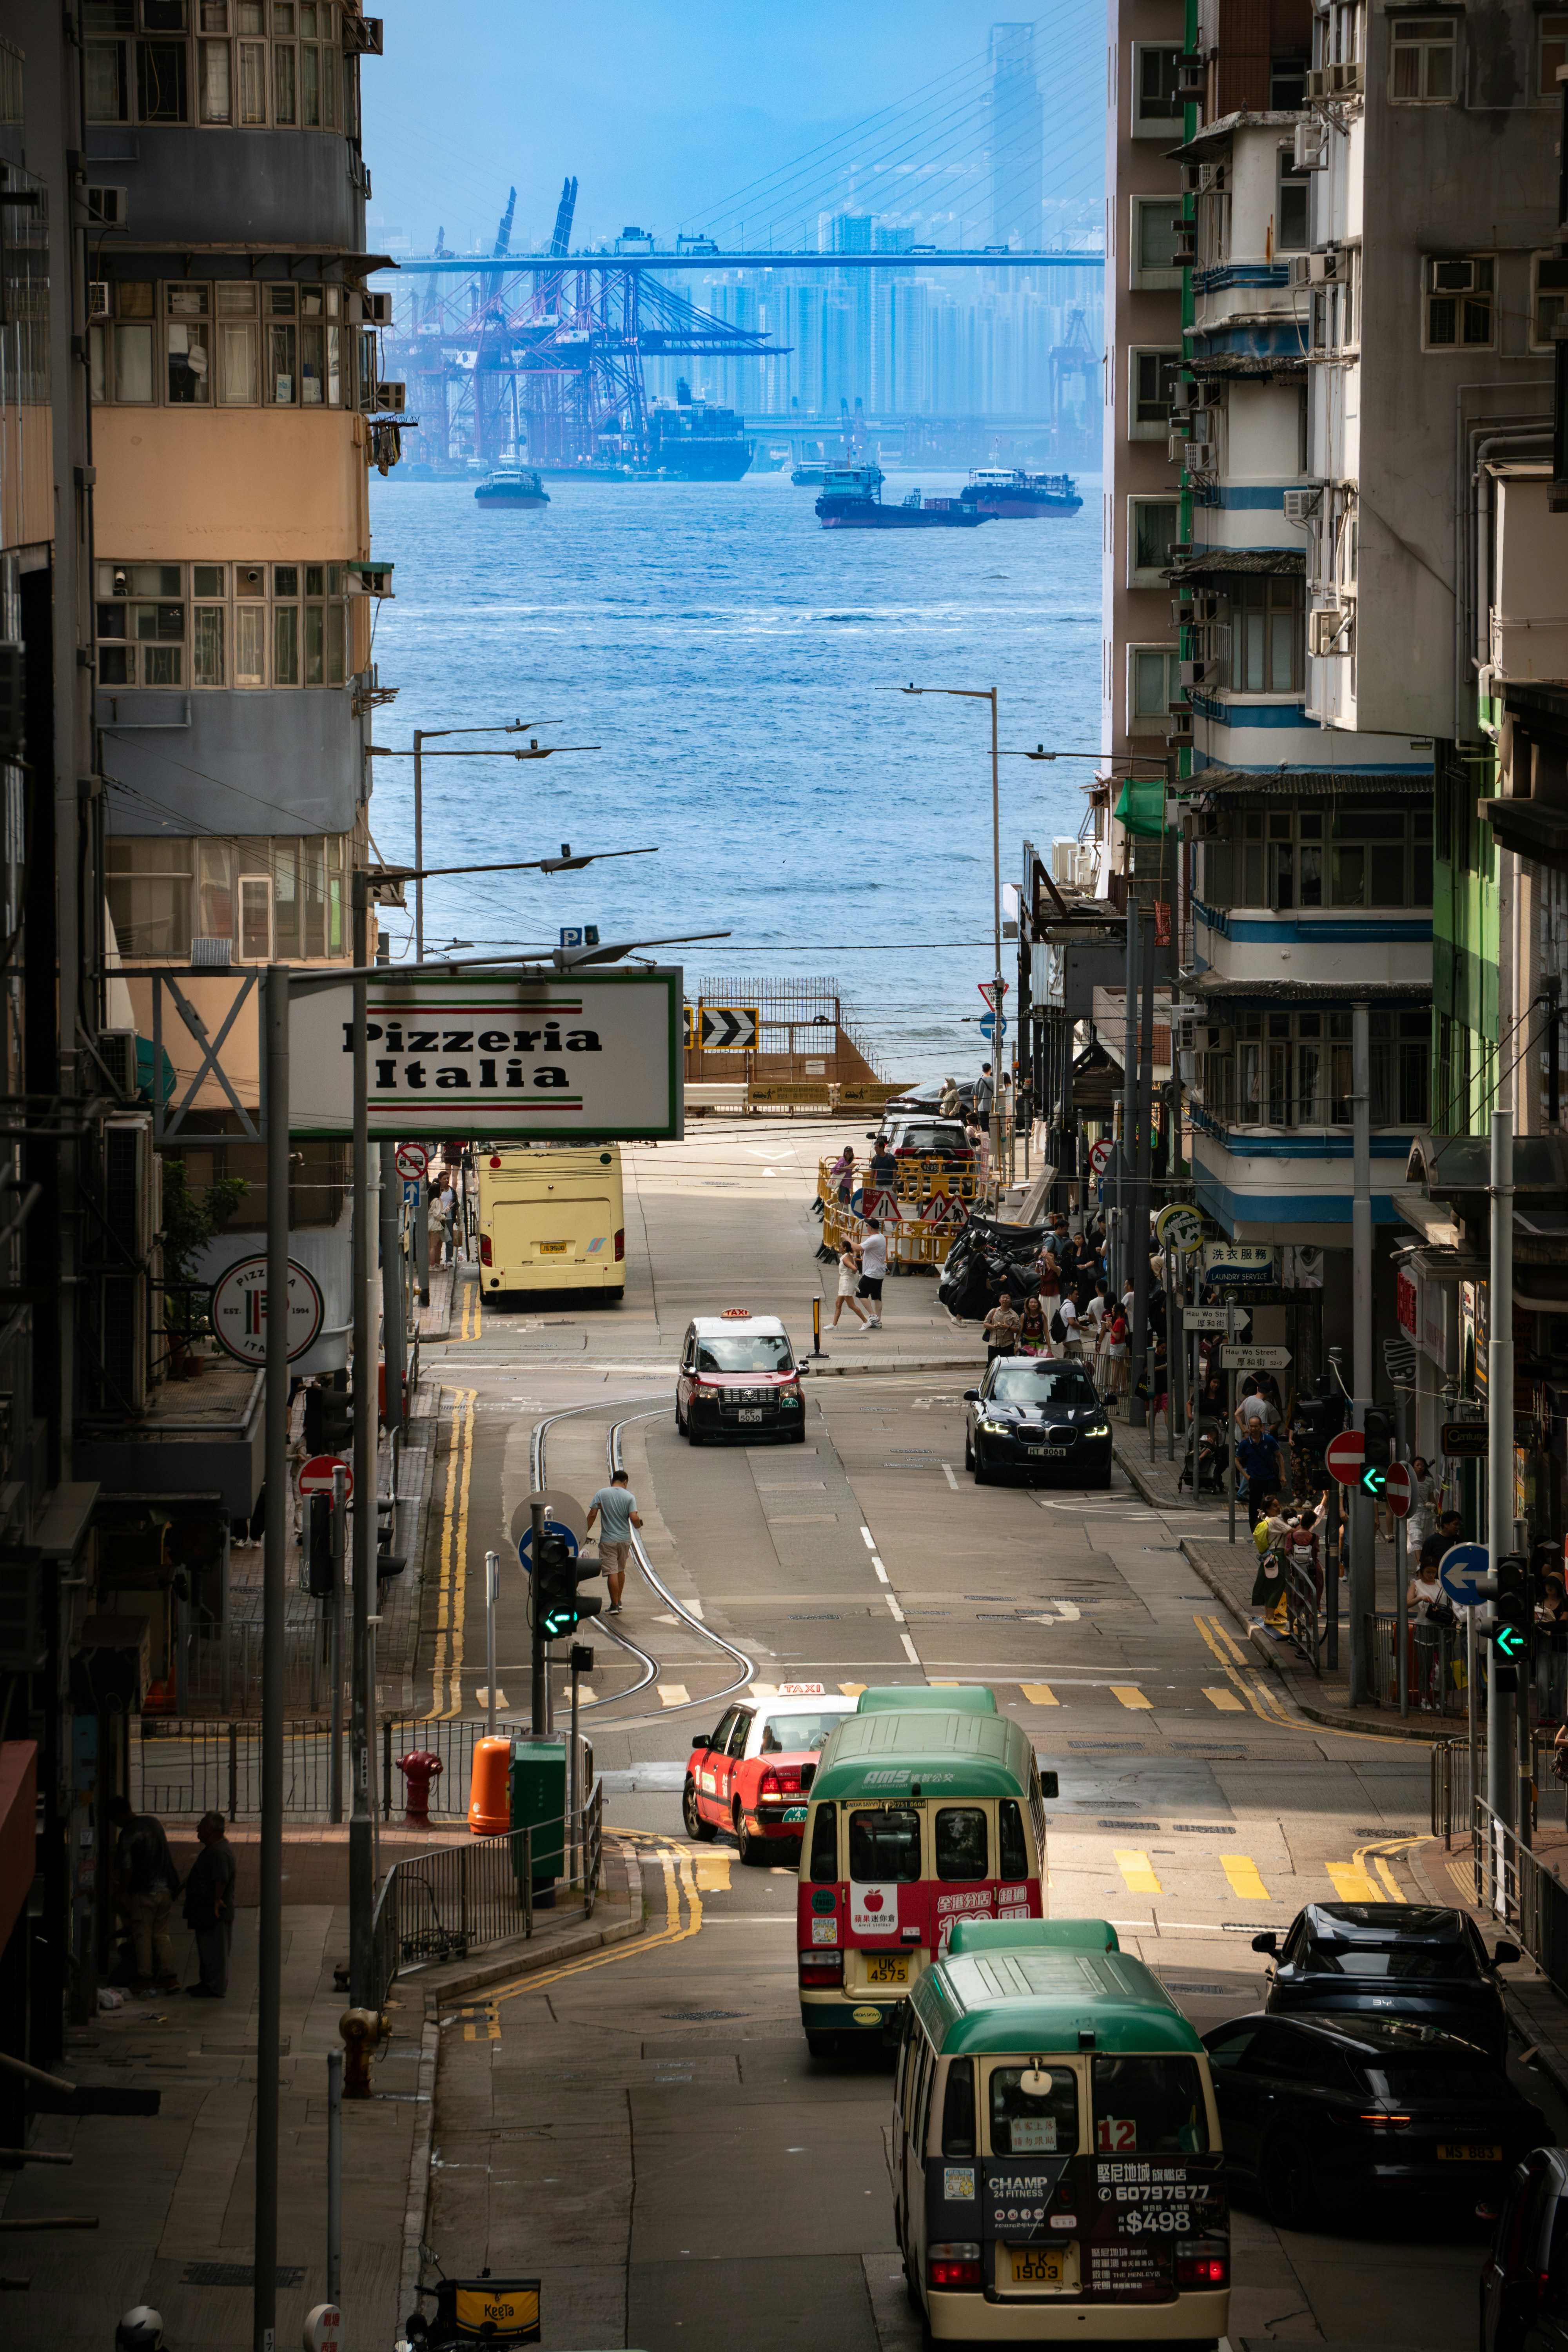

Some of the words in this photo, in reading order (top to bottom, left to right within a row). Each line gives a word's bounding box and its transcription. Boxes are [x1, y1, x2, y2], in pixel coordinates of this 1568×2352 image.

[343, 1022, 602, 1053] Pizzeria
[376, 1058, 569, 1088] Italia
[1212, 1249, 1267, 1260] 洗衣服務
[236, 1269, 296, 1287] PIZZA
[1197, 1319, 1224, 1327] 厚和街
[785, 1684, 820, 1693] TAXI
[864, 1770, 911, 1784] AMS
[939, 1892, 990, 1911] 全港分店
[1000, 1887, 1025, 1902] 超過
[855, 1914, 895, 1923] 蘋果迷你倉
[879, 1959, 896, 1971] UK
[871, 1969, 906, 1981] 4575
[1098, 2120, 1136, 2151] 12
[1445, 2145, 1463, 2158] MS
[1468, 2146, 1495, 2159] 883
[1098, 2163, 1150, 2183] 堅尼地城
[1152, 2169, 1187, 2181] 旗艦店
[989, 2177, 1048, 2189] CHAMP
[1006, 2189, 1044, 2198] FITNESS
[1116, 2185, 1209, 2201] 60797677
[1126, 2210, 1191, 2235] $498
[1025, 2252, 1048, 2266] LK
[1091, 2248, 1128, 2257] 堅尼地城
[1016, 2265, 1058, 2279] 1903
[1093, 2281, 1111, 2290] 元朗
[485, 2304, 514, 2320] KeeTa
